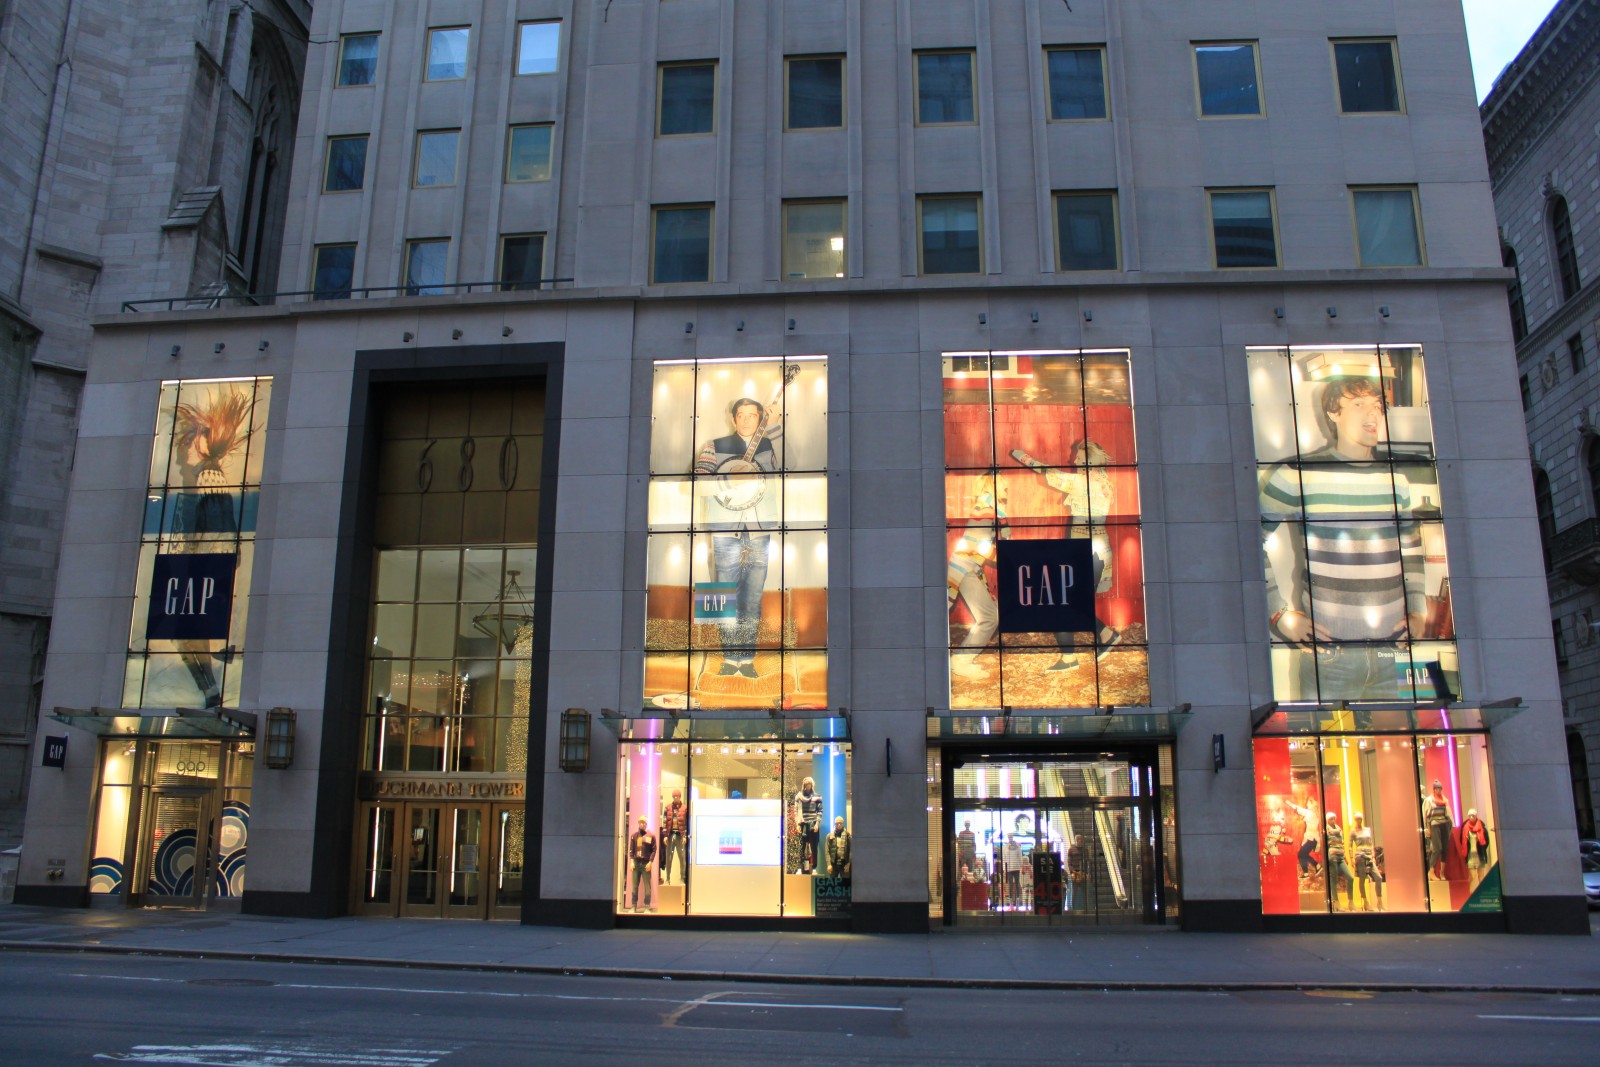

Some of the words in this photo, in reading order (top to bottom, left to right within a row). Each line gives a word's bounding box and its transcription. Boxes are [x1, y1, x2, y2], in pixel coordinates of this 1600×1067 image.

[417, 436, 519, 494] 680
[1018, 564, 1074, 606] GAP
[165, 577, 215, 616] GAP
[703, 594, 727, 612] GAP
[1405, 667, 1429, 685] GAP
[49, 744, 64, 760] GAP
[177, 761, 206, 776] gap
[468, 781, 524, 798] TOWER
[816, 876, 843, 887] GAP
